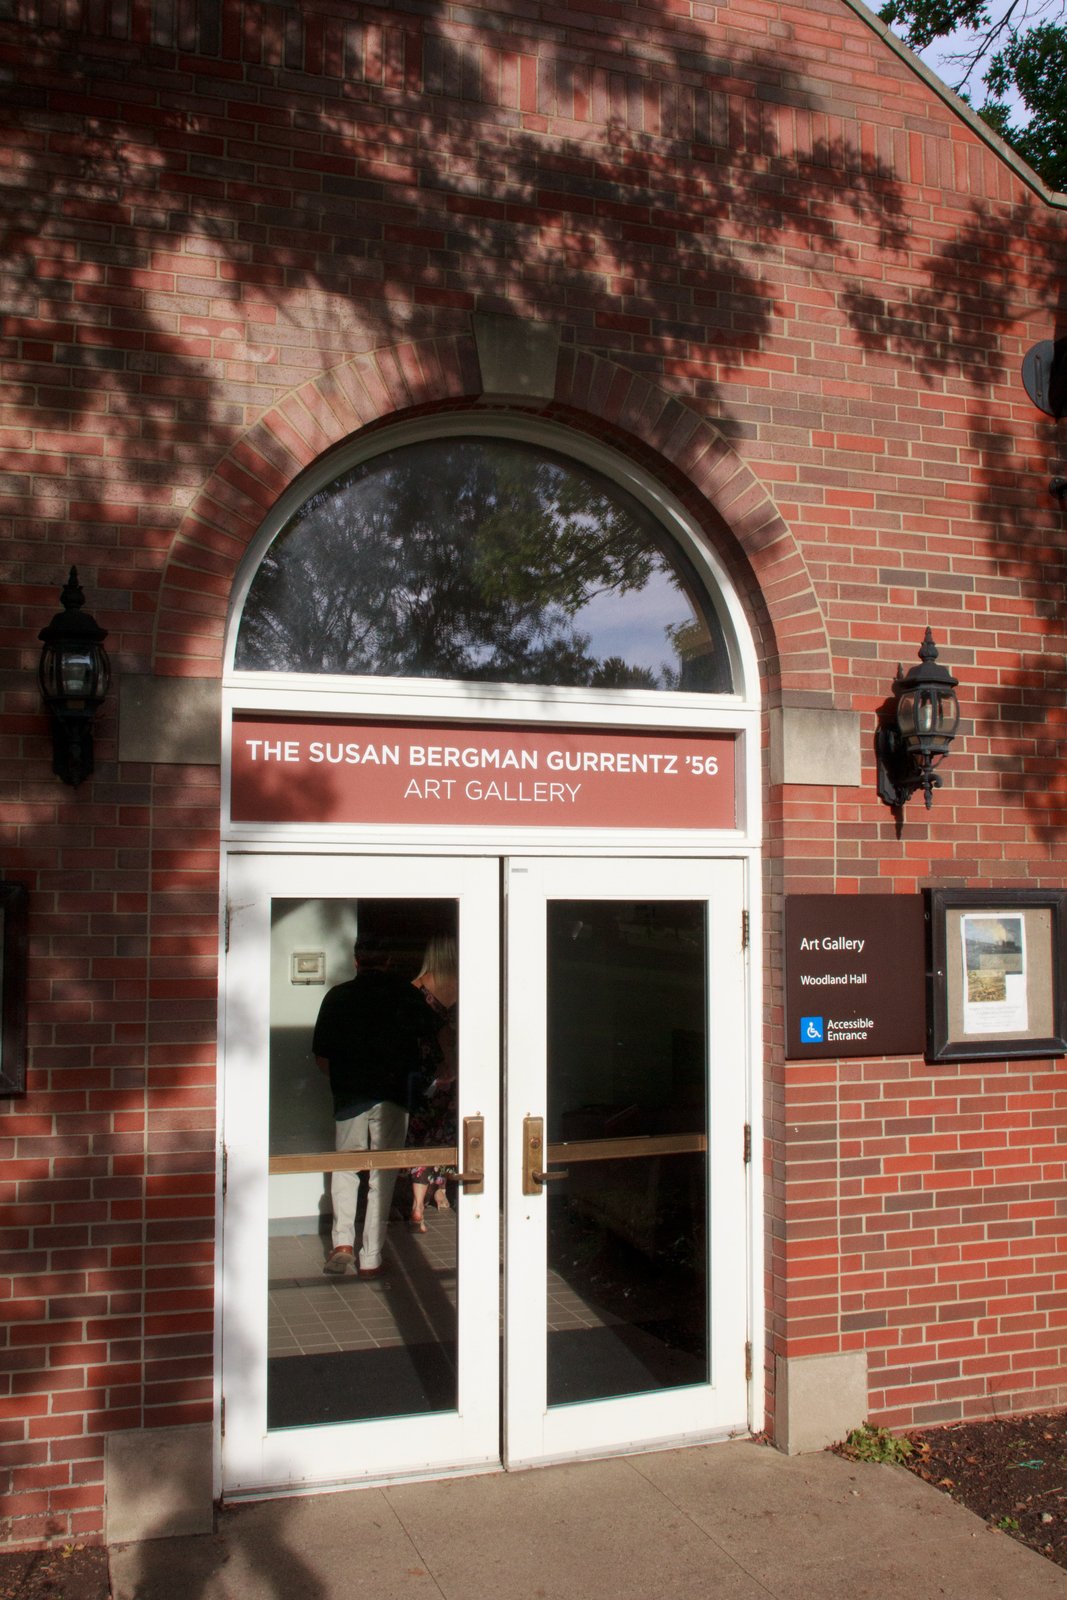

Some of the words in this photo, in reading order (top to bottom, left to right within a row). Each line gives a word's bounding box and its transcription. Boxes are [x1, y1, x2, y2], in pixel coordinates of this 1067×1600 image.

[245, 740, 301, 763] THE
[308, 742, 400, 766] SUSAN
[409, 746, 538, 770] BERGMAN
[546, 750, 678, 774] GURRENTZ
[403, 778, 457, 800] ART
[464, 780, 582, 803] GALLERY
[800, 937, 820, 951] Art
[822, 936, 865, 952] Gallery
[800, 974, 848, 985] Woodland
[849, 973, 867, 984] Hall
[827, 1018, 874, 1029] Accessible
[827, 1031, 868, 1041] Entrance
